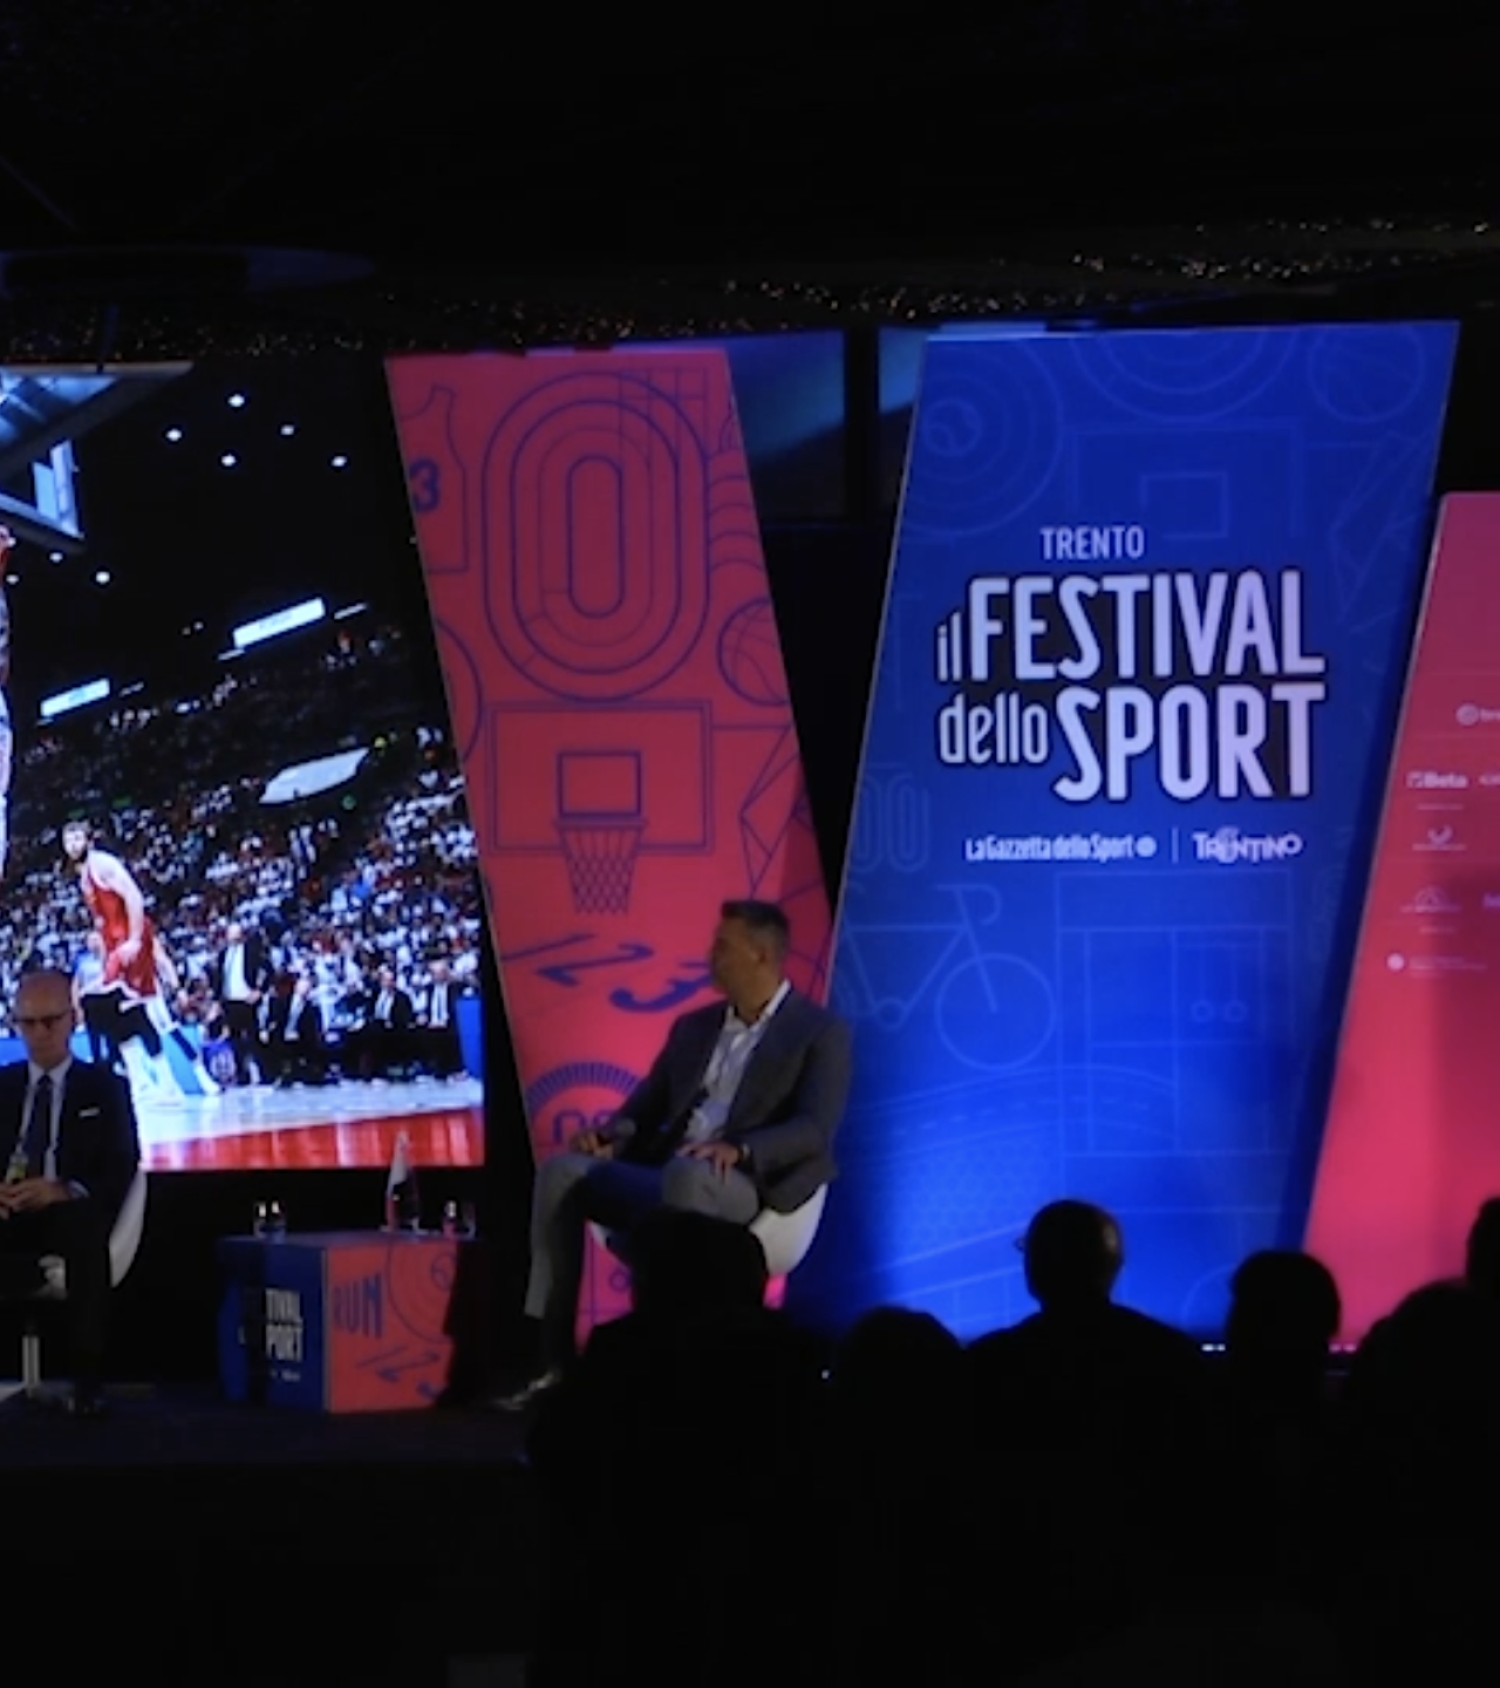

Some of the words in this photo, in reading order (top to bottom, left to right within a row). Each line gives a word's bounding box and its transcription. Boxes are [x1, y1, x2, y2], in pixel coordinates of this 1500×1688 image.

[1040, 525, 1147, 561] TRENTO
[937, 611, 963, 682] il
[970, 569, 1326, 682] FESTIVAL
[938, 693, 1049, 765] dello
[1052, 682, 1326, 802] SPORT
[987, 834, 1051, 861] Gazzetta
[1052, 834, 1090, 860] dello
[1090, 831, 1134, 864] Sport
[1192, 826, 1303, 864] TRENTINO
[334, 1273, 383, 1339] RUN
[265, 1318, 303, 1362] PORT
